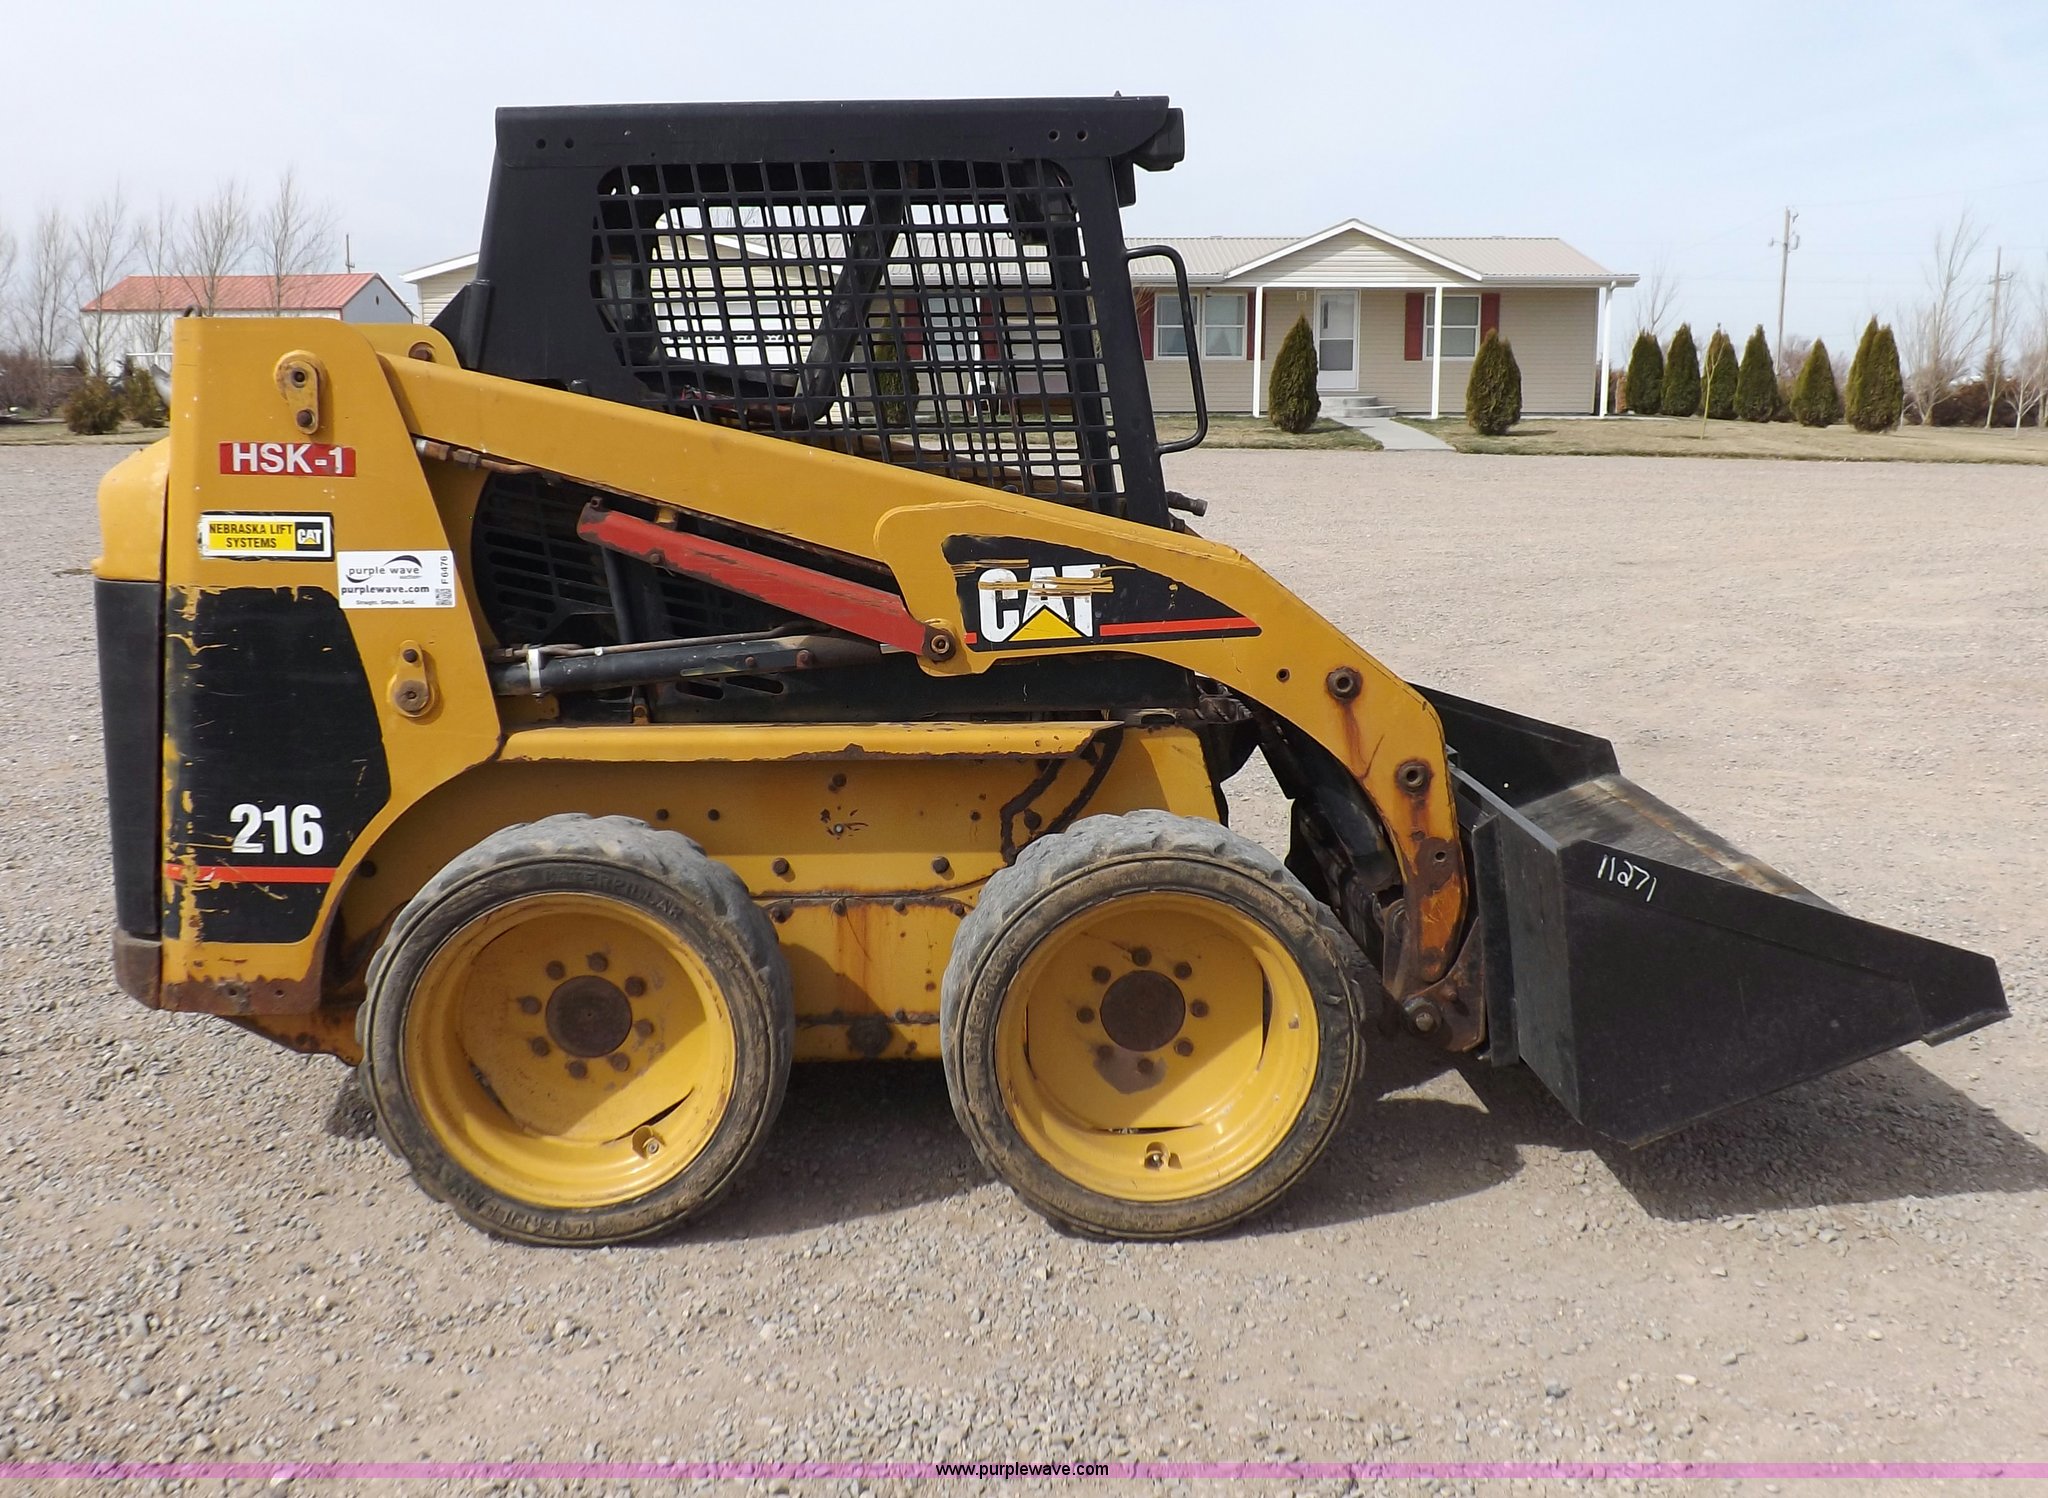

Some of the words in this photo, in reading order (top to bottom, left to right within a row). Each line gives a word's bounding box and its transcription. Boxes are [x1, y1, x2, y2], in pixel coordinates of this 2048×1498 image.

[231, 442, 343, 474] HSK-1
[208, 523, 267, 535] NEBRASKA
[270, 524, 293, 535] LIFT
[297, 528, 322, 545] CAT
[226, 537, 277, 548] SYSTEMS
[348, 566, 386, 575] purple
[341, 585, 430, 595] purplewave.com
[978, 563, 1102, 643] CAT
[229, 803, 324, 856] 216
[1597, 854, 1657, 902] 11271
